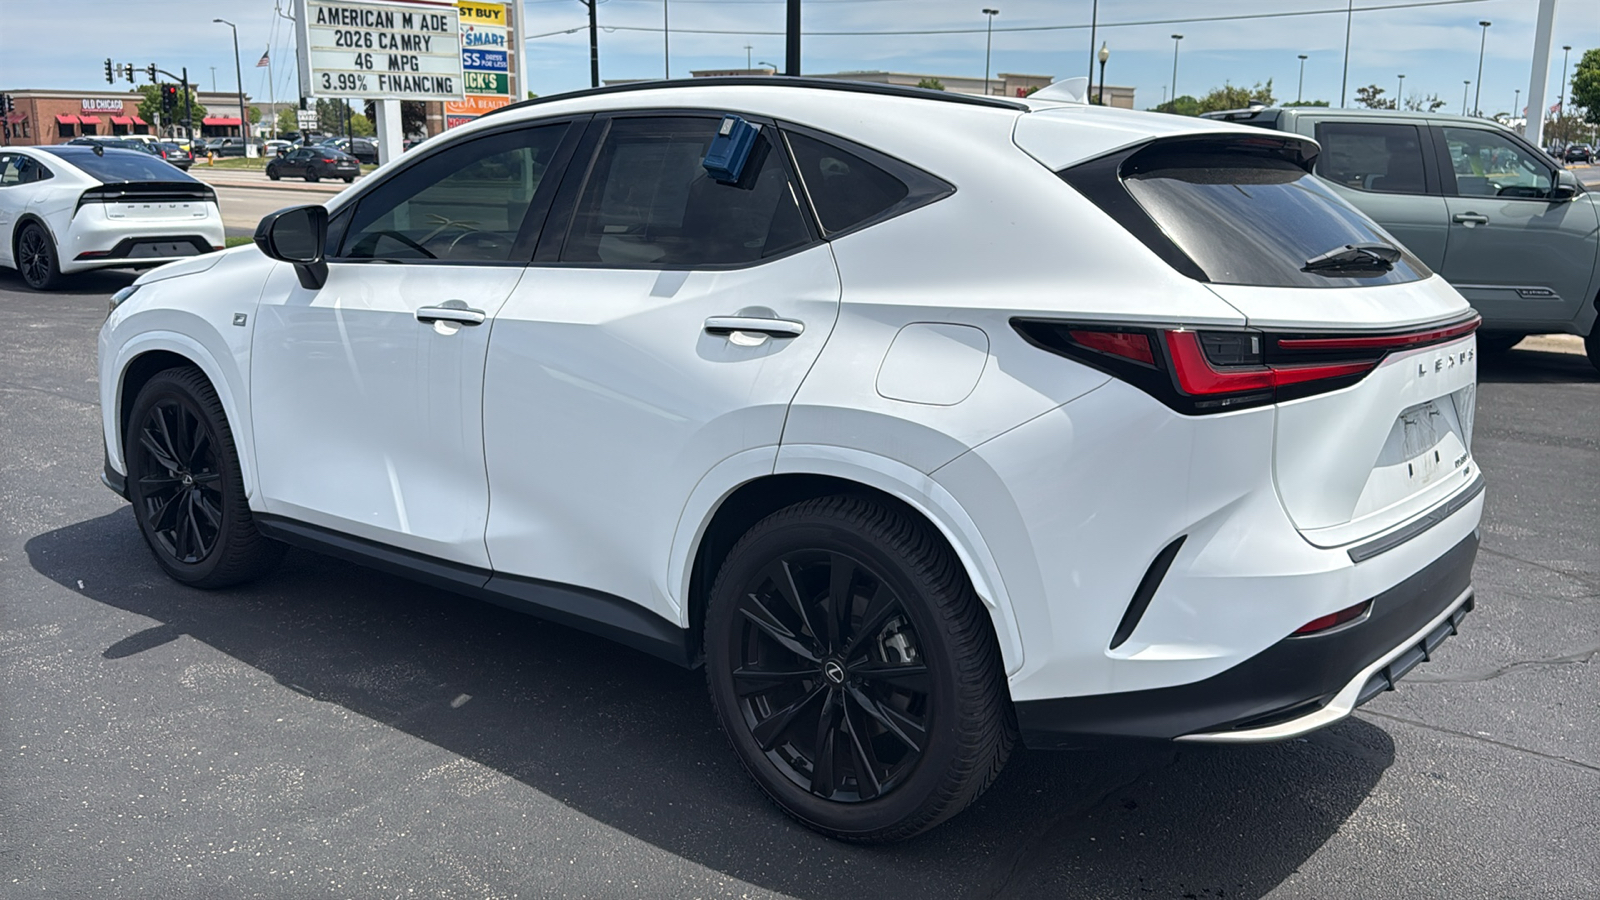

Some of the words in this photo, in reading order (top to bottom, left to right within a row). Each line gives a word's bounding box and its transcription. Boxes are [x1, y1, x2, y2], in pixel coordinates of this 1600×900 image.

[316, 6, 394, 29] AMERICAN
[475, 8, 502, 19] BUY
[335, 29, 373, 49] 2026
[378, 32, 431, 52] CAMRY
[354, 52, 373, 70] 46
[388, 54, 419, 72] MPG
[322, 72, 367, 91] 3.99%
[378, 74, 453, 93] FINANCING
[465, 72, 497, 88] ICK'S
[82, 99, 95, 109] OLD
[96, 99, 124, 110] CHICAGO
[1418, 349, 1474, 377] LEXUS
